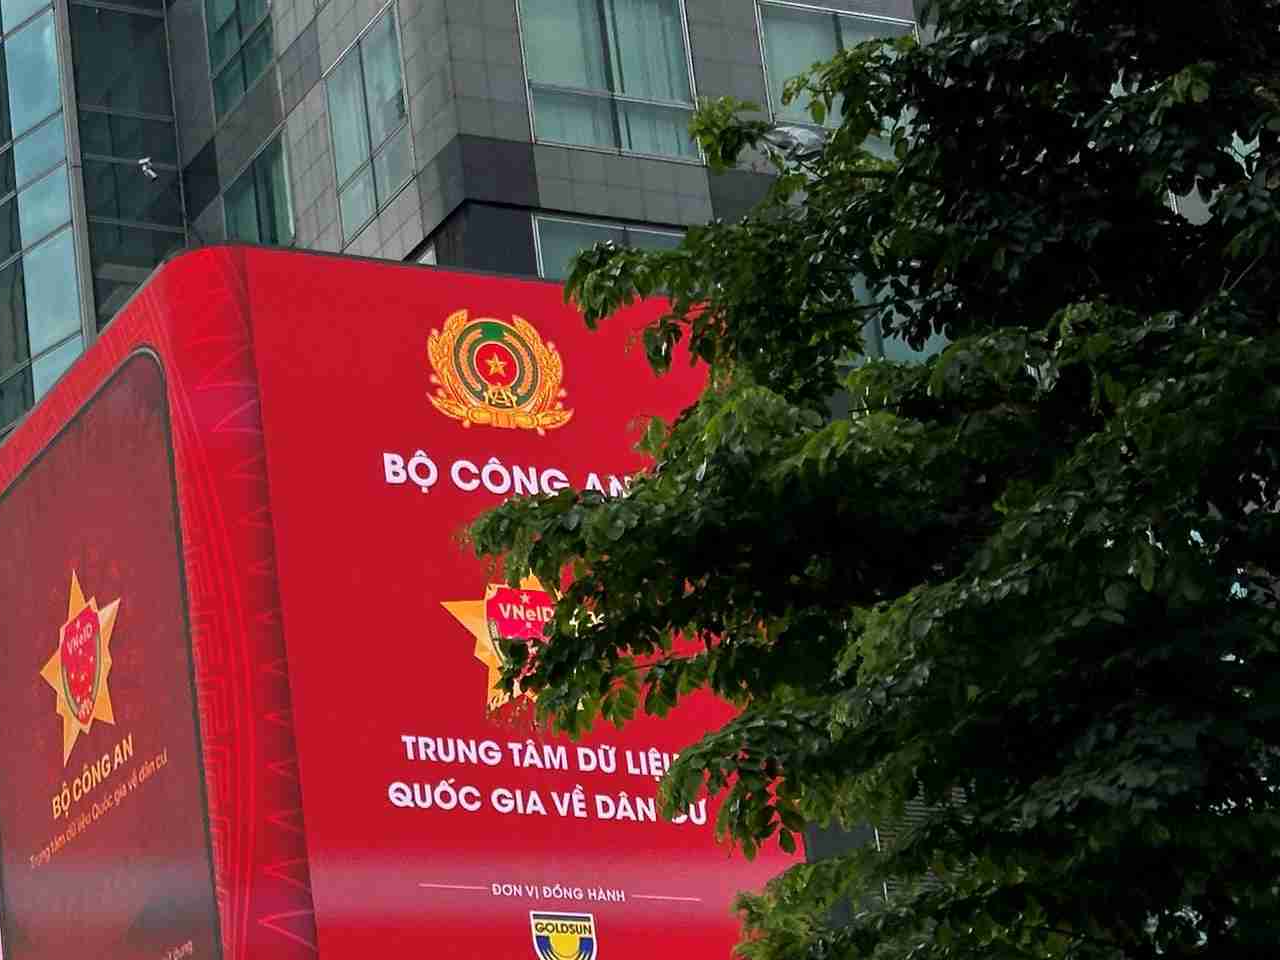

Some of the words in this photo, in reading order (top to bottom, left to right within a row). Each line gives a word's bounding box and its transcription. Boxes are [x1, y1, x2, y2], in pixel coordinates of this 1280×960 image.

[383, 450, 438, 493] BỘ
[451, 457, 570, 497] CÔNG
[401, 735, 502, 766] TRUNG
[508, 739, 569, 771] TÂM
[578, 744, 617, 774] DỮ
[52, 780, 70, 820] BỘ
[74, 755, 111, 799] CÔNG
[114, 733, 134, 771] AN
[388, 778, 481, 812] QUỐC
[490, 787, 545, 816] GIA
[553, 785, 587, 818] VỀ
[596, 787, 657, 823] DÂN
[492, 882, 522, 898] ĐƠN
[525, 884, 539, 900] VỊ
[542, 881, 583, 900] ĐỒNG
[588, 882, 625, 902] HÀNH
[535, 920, 592, 936] GOLDSUN
